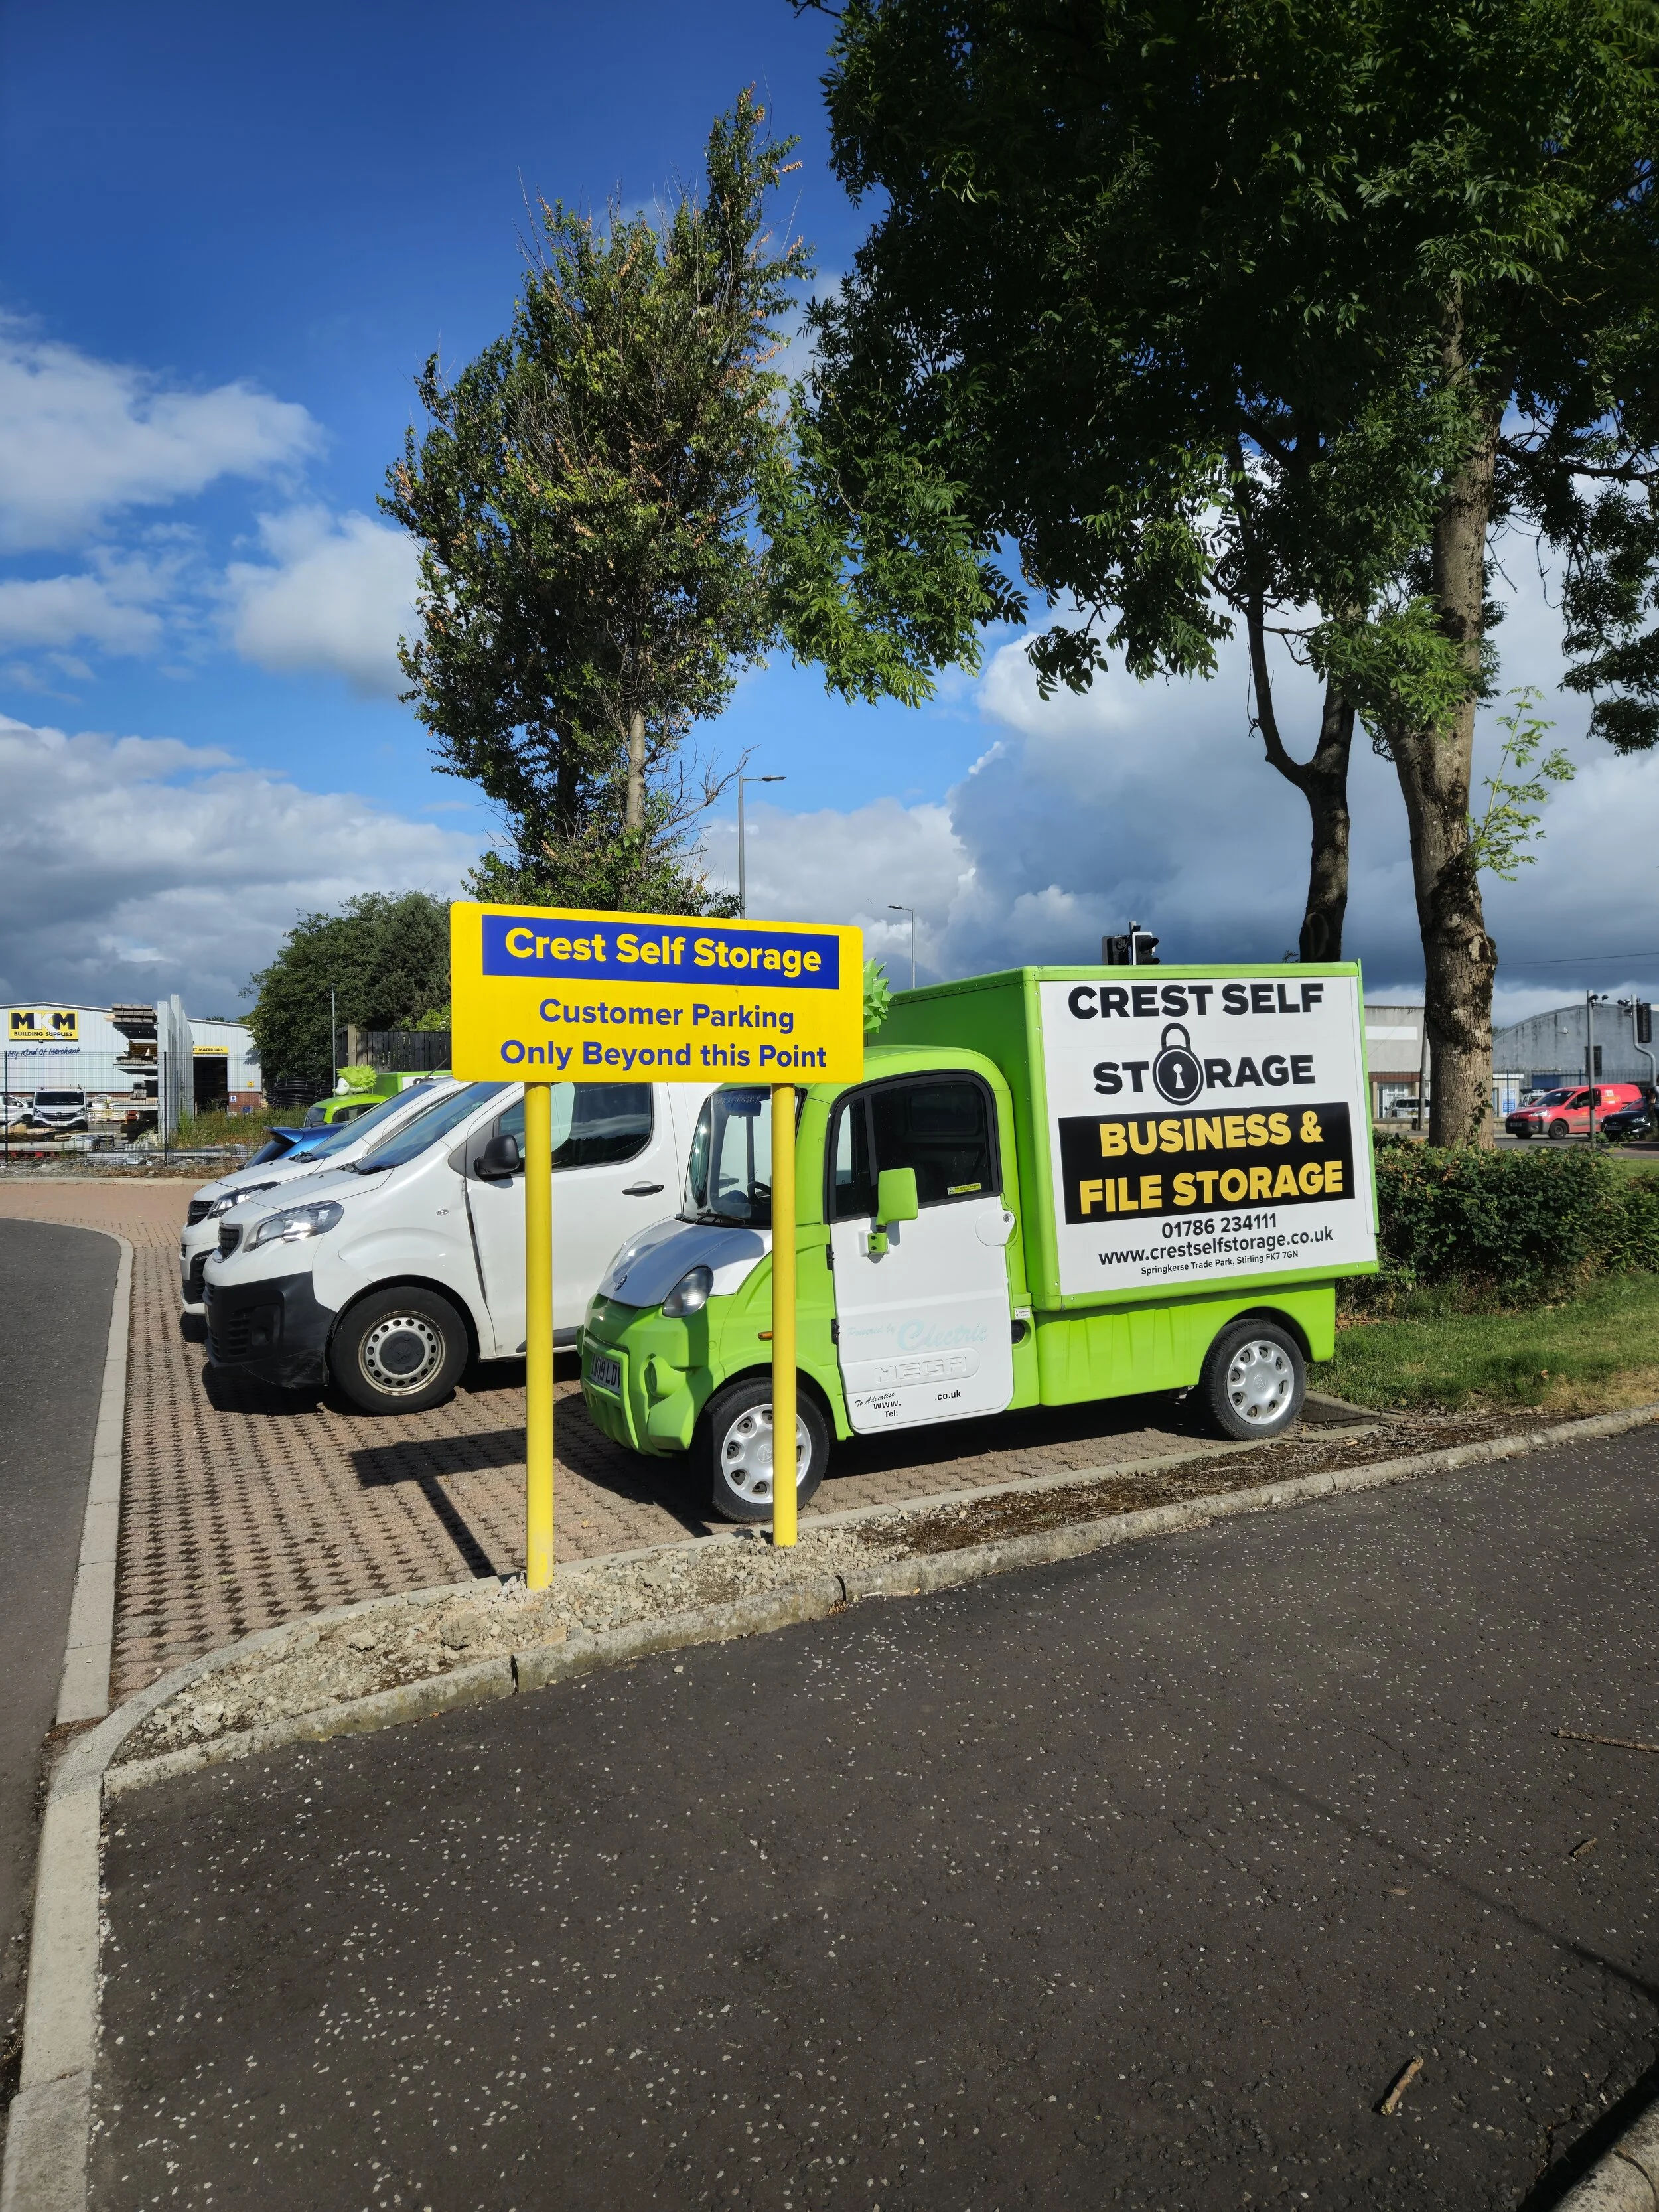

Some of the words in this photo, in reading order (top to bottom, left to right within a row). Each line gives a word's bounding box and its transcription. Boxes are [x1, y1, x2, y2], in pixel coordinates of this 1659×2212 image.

[505, 927, 606, 962] Crest
[616, 933, 686, 965] Self
[694, 937, 822, 978] Storage
[540, 998, 684, 1027] Customer
[693, 1003, 794, 1034] Parking
[1068, 984, 1214, 1020] CREST
[1222, 982, 1324, 1016] SELF
[11, 1012, 76, 1030] MKM
[8, 1050, 19, 1060] My
[21, 1048, 38, 1057] Kind
[49, 1047, 80, 1055] Merchant
[501, 1039, 573, 1071] Only
[583, 1041, 691, 1071] Beyond
[701, 1043, 751, 1067] this
[760, 1045, 827, 1068] Point
[1099, 1112, 1291, 1157] BUSINESS
[1300, 1110, 1325, 1143] &
[1079, 1174, 1163, 1215] FILE
[1172, 1160, 1344, 1207] STORAGE
[1161, 1217, 1216, 1240] 01786
[1220, 1212, 1277, 1234] 234111
[1098, 1225, 1334, 1266] www.crestselfstorage.co.uk
[1141, 1264, 1189, 1276] Springkerse
[1190, 1260, 1213, 1270] Trade
[1215, 1256, 1235, 1266] Park,
[1236, 1252, 1264, 1264] Stirling
[1265, 1251, 1281, 1261] FK7
[1282, 1249, 1299, 1259] 7GN
[874, 1356, 967, 1383] MEGA
[855, 1399, 863, 1408] To
[864, 1392, 895, 1406] Advertise
[873, 1400, 901, 1410] www.
[934, 1390, 962, 1401] .co.uk
